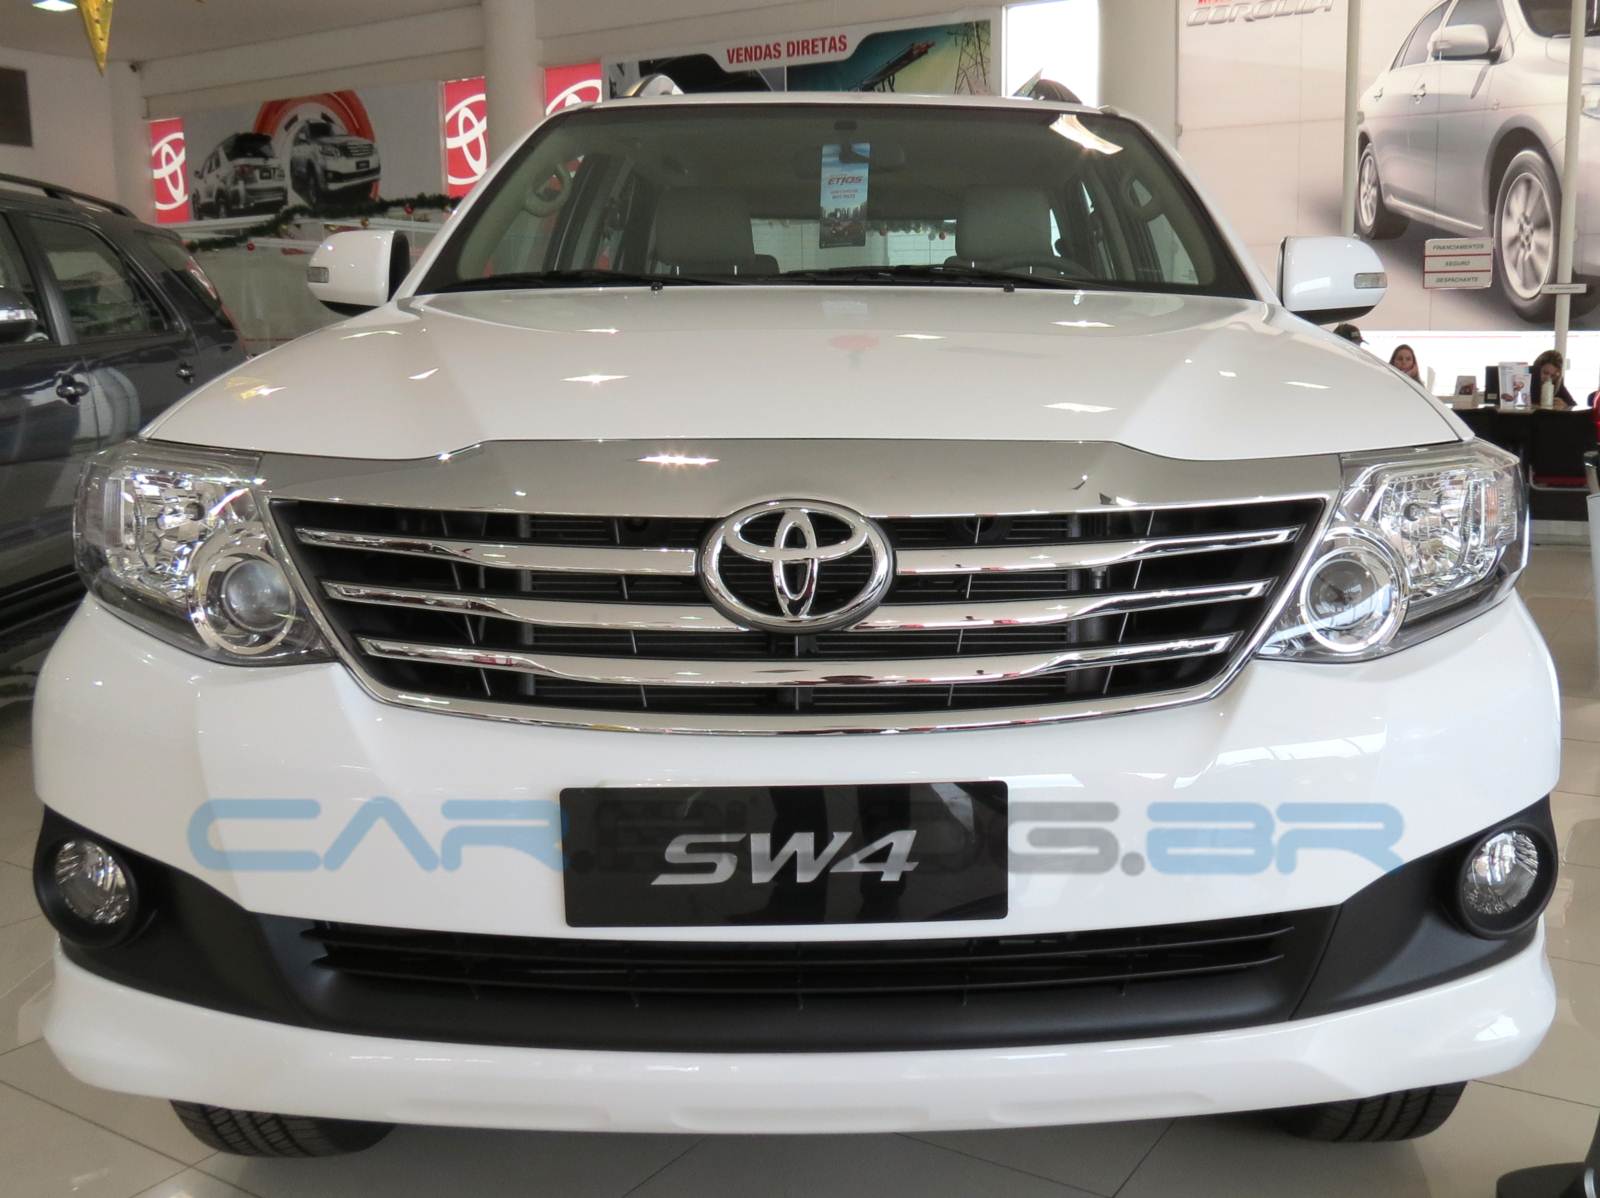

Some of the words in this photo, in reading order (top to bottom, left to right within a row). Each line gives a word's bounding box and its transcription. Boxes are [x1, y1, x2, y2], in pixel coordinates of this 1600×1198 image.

[1186, 0, 1333, 27] COROLLA
[726, 42, 782, 64] VENDAS
[786, 34, 848, 58] DIRETAS
[651, 829, 919, 885] SW4
